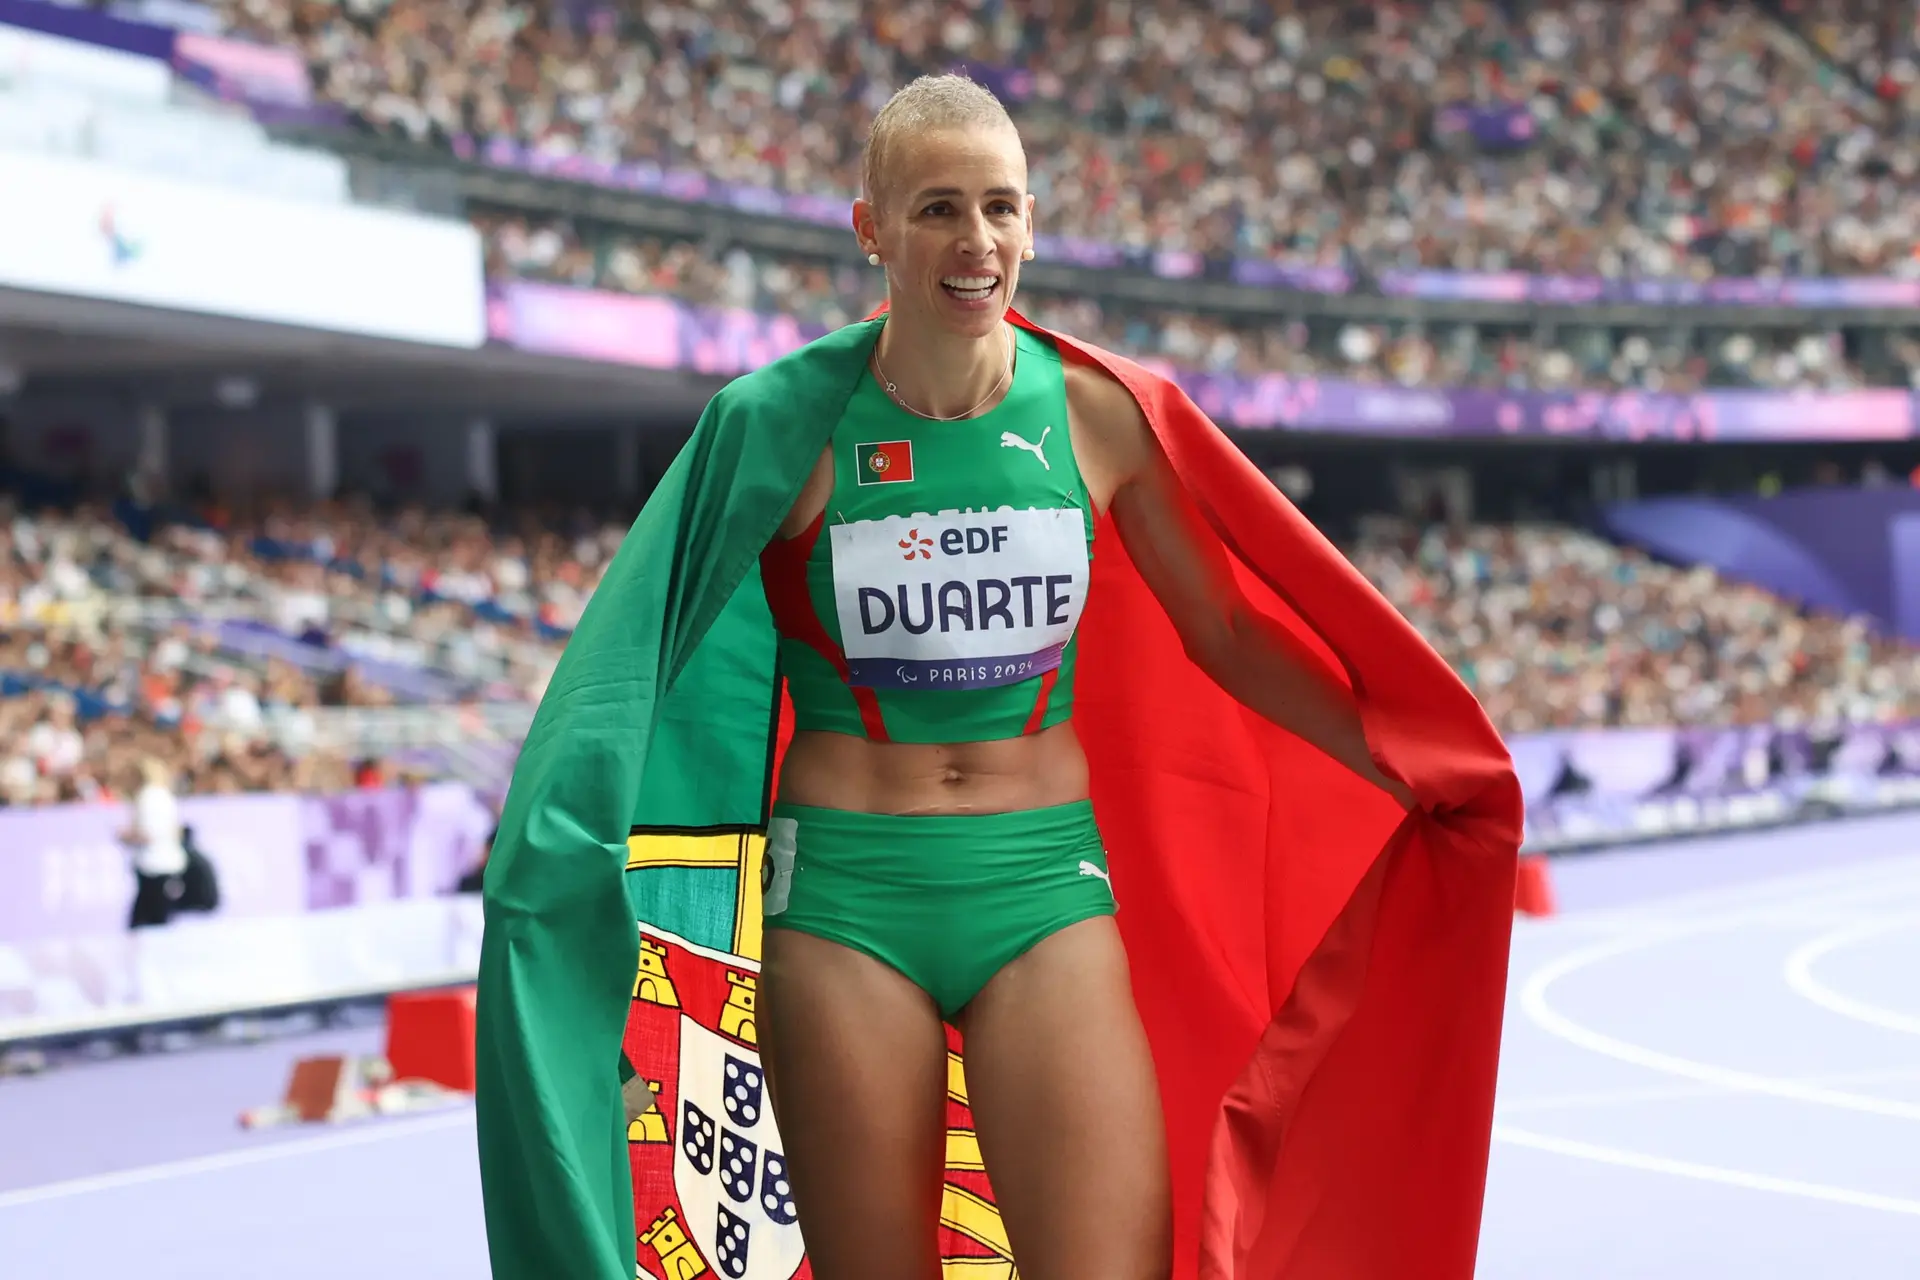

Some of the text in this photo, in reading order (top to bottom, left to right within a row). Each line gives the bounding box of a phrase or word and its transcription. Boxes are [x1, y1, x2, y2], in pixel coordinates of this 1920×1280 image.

[857, 574, 1073, 636] DUARTE
[929, 661, 1033, 682] PARIS 2024
